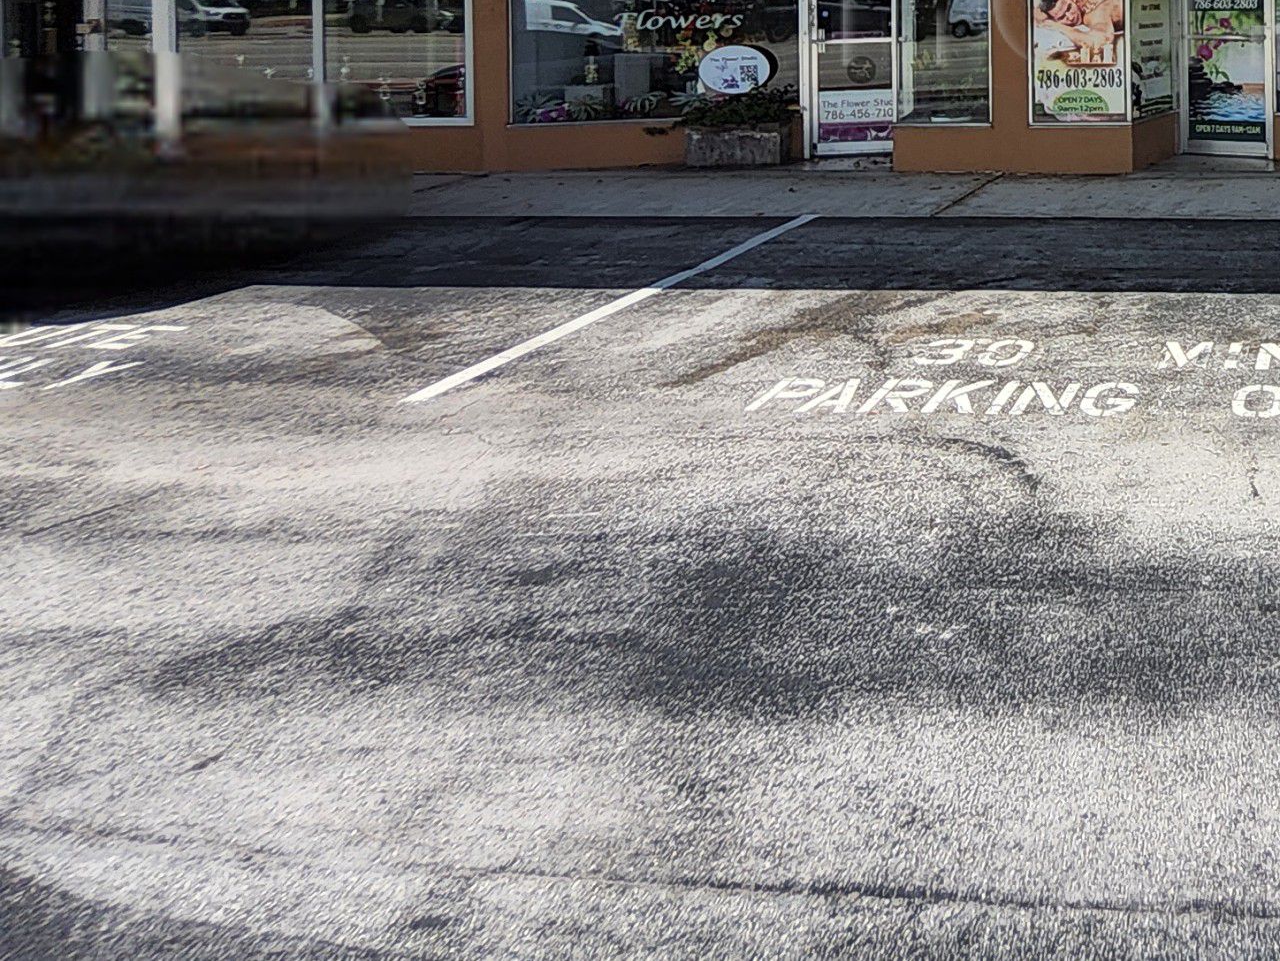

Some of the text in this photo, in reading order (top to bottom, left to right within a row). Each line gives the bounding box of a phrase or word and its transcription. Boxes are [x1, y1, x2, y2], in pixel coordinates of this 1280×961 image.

[612, 8, 744, 30] Flowers
[821, 100, 838, 109] The
[840, 99, 869, 109] Flower
[1196, 125, 1210, 133] OPEN
[914, 338, 1035, 367] 30
[743, 377, 1140, 417] PARKING
